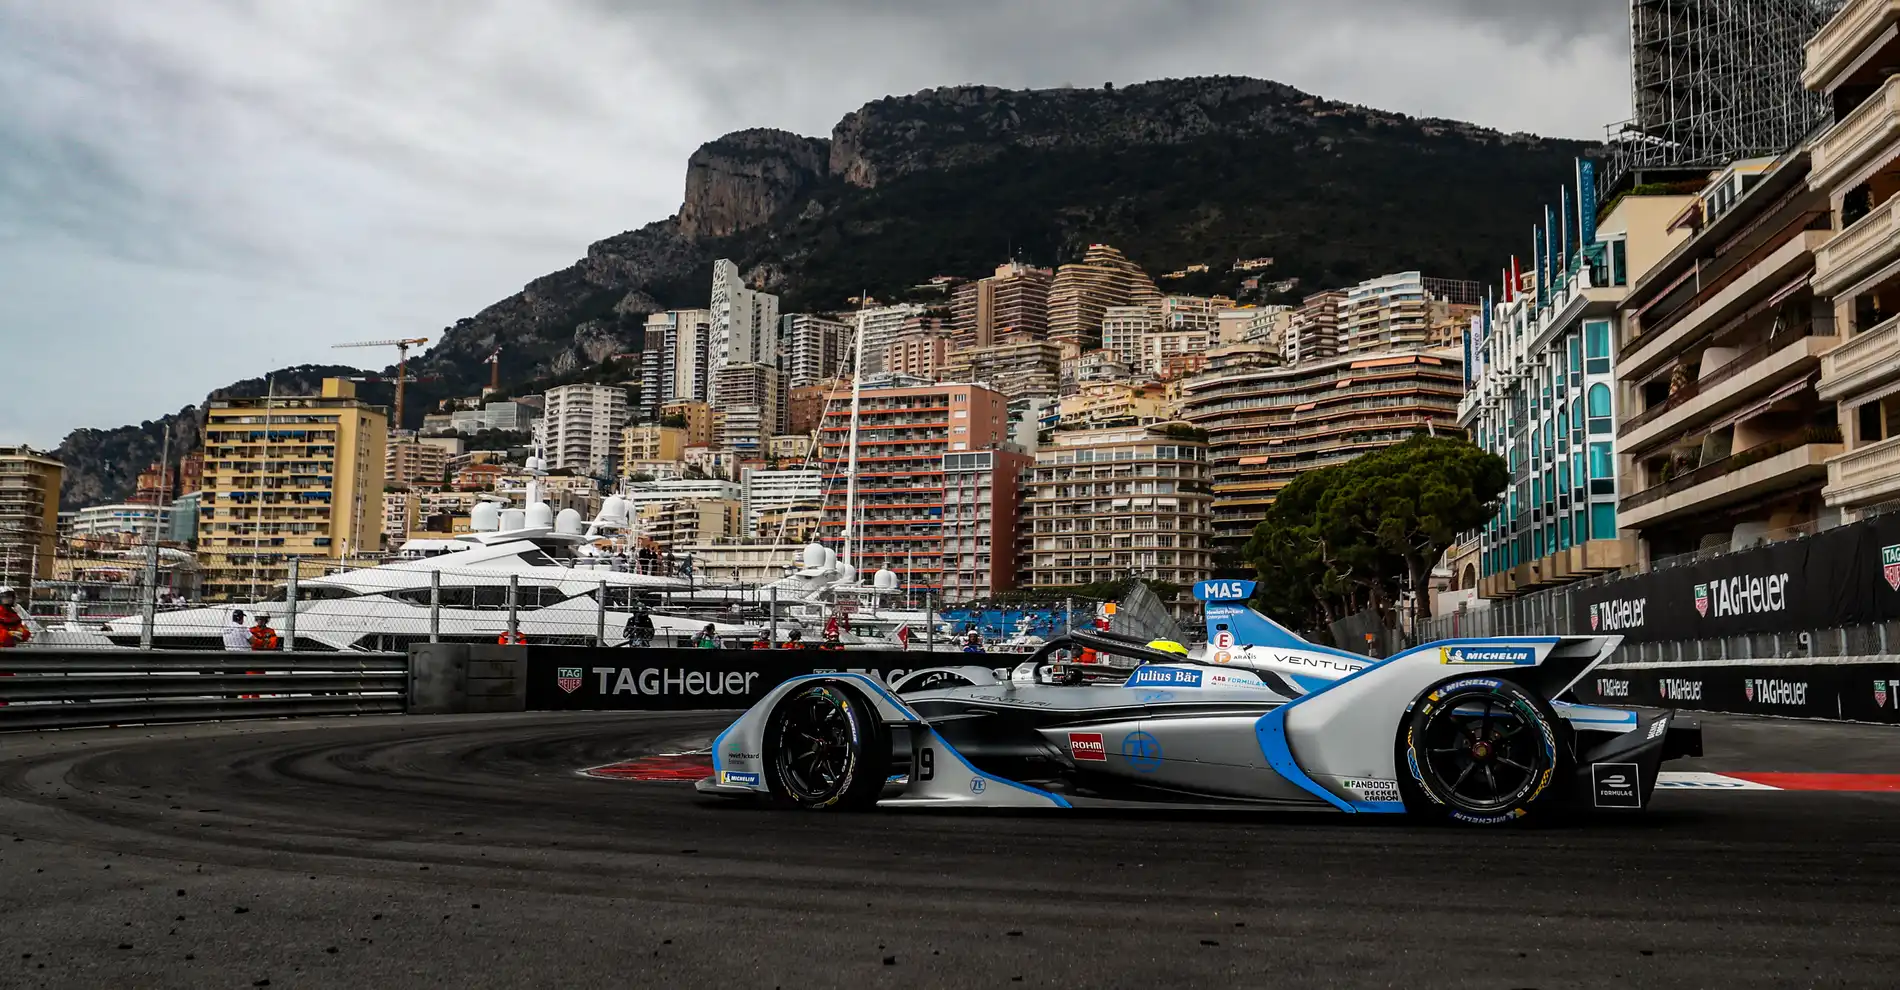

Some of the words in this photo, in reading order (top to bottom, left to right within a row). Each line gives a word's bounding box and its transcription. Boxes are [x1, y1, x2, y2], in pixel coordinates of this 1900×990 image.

[1204, 582, 1243, 598] MAS
[1710, 573, 1789, 617] TAGHeuer
[1600, 598, 1646, 631] TAGHeuer
[1219, 634, 1229, 648] E
[1466, 652, 1528, 660] MICHELIN
[561, 670, 580, 678] TAG
[1135, 671, 1171, 684] Julius
[1175, 671, 1200, 683] Bär
[592, 667, 760, 695] TAGHeuer
[1446, 679, 1498, 692] MICHELIN
[1755, 679, 1808, 705] TAGHeuer
[1071, 741, 1102, 750] ROHM
[914, 748, 934, 781] 19
[1351, 780, 1396, 789] FANBOOST
[1454, 812, 1506, 824] MICHELIN
